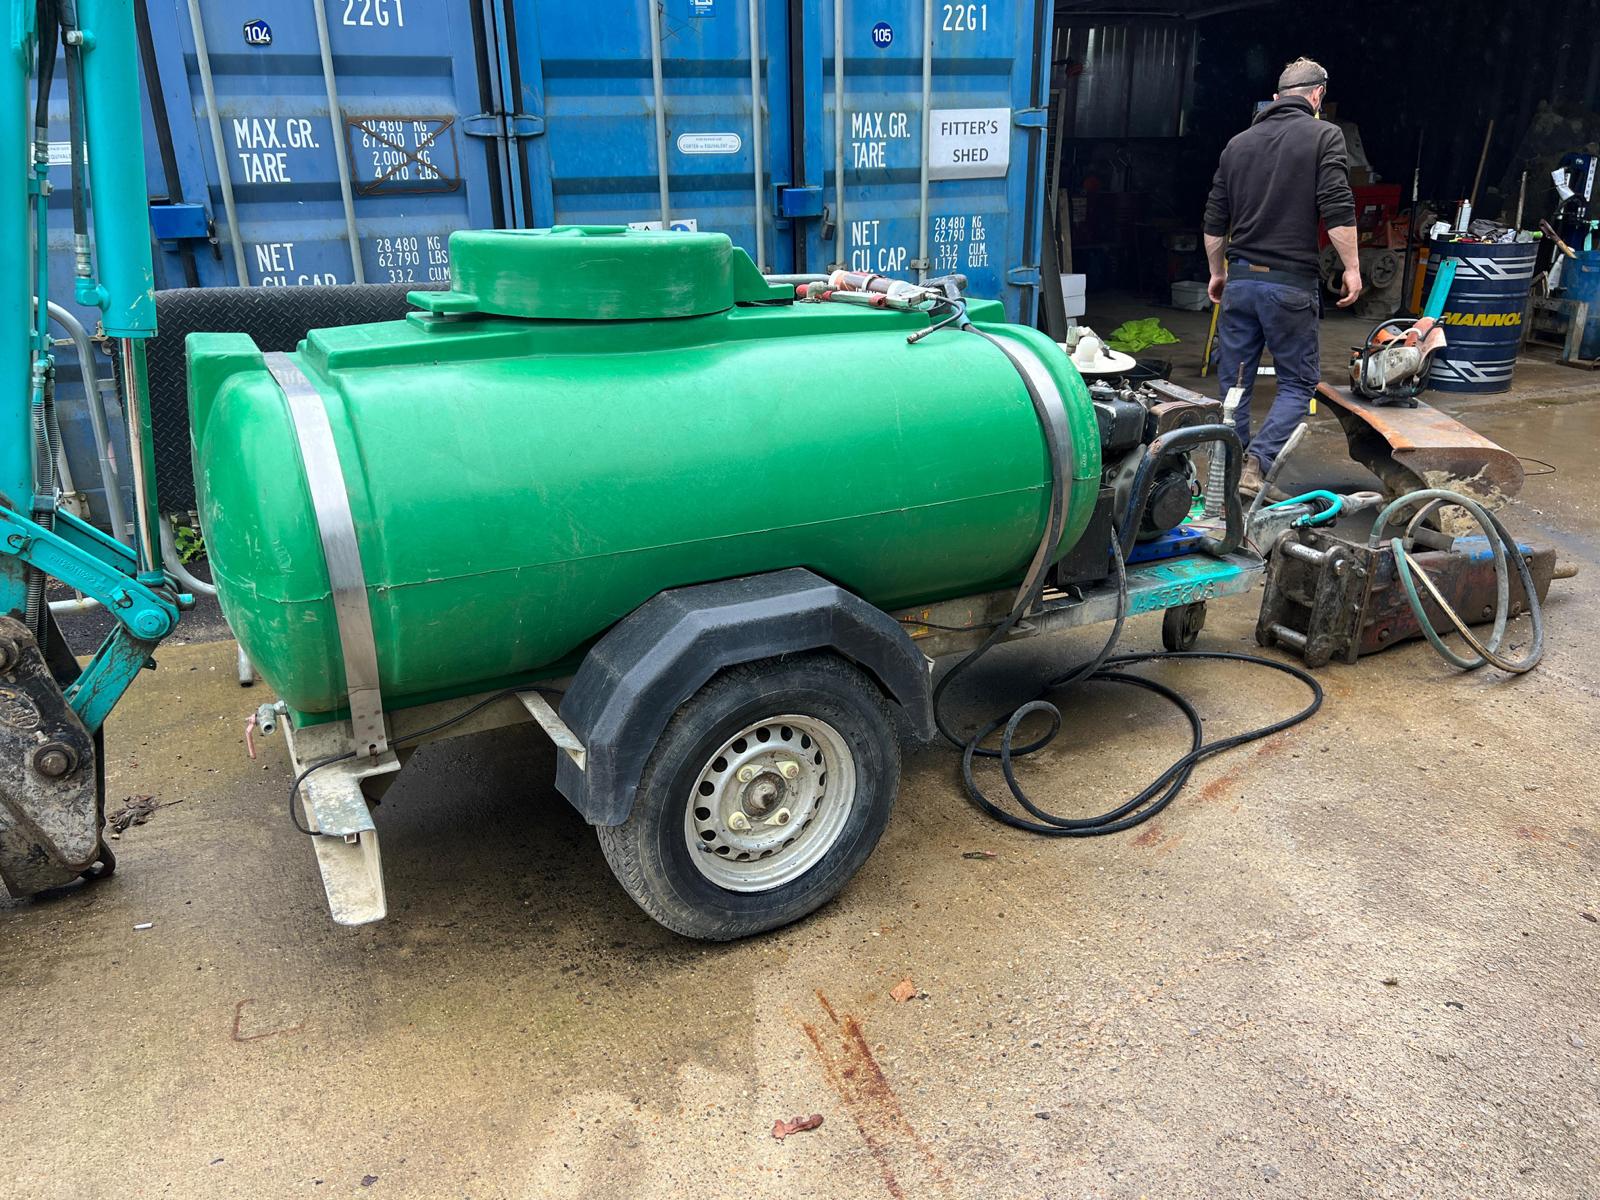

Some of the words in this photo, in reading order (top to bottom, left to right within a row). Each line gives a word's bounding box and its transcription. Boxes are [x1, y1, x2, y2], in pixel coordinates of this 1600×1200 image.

[342, 0, 403, 26] 22G1
[943, 4, 987, 31] 22G1
[245, 26, 270, 41] 104
[873, 28, 891, 42] 105
[413, 120, 427, 132] KG
[415, 132, 435, 148] LBS
[372, 150, 407, 166] 2.000
[852, 142, 886, 168] TARE
[953, 148, 989, 162] SHED
[239, 153, 291, 183] TARE
[418, 163, 439, 180] LBS
[934, 216, 965, 230] 28.480
[972, 216, 982, 228] KG
[852, 220, 880, 247] NET
[934, 229, 965, 243] 62.790
[971, 228, 986, 241] LBS
[376, 237, 418, 253] 28.480
[427, 236, 440, 250] KG
[940, 244, 958, 257] 33.2
[256, 243, 294, 272] NET
[379, 252, 420, 267] 62.790
[429, 250, 448, 265] LBS
[852, 248, 874, 273] CU.
[878, 246, 909, 272] CAP.
[935, 257, 958, 270] 1.172
[389, 268, 415, 283] 33.2
[1443, 312, 1522, 327] MANNOL
